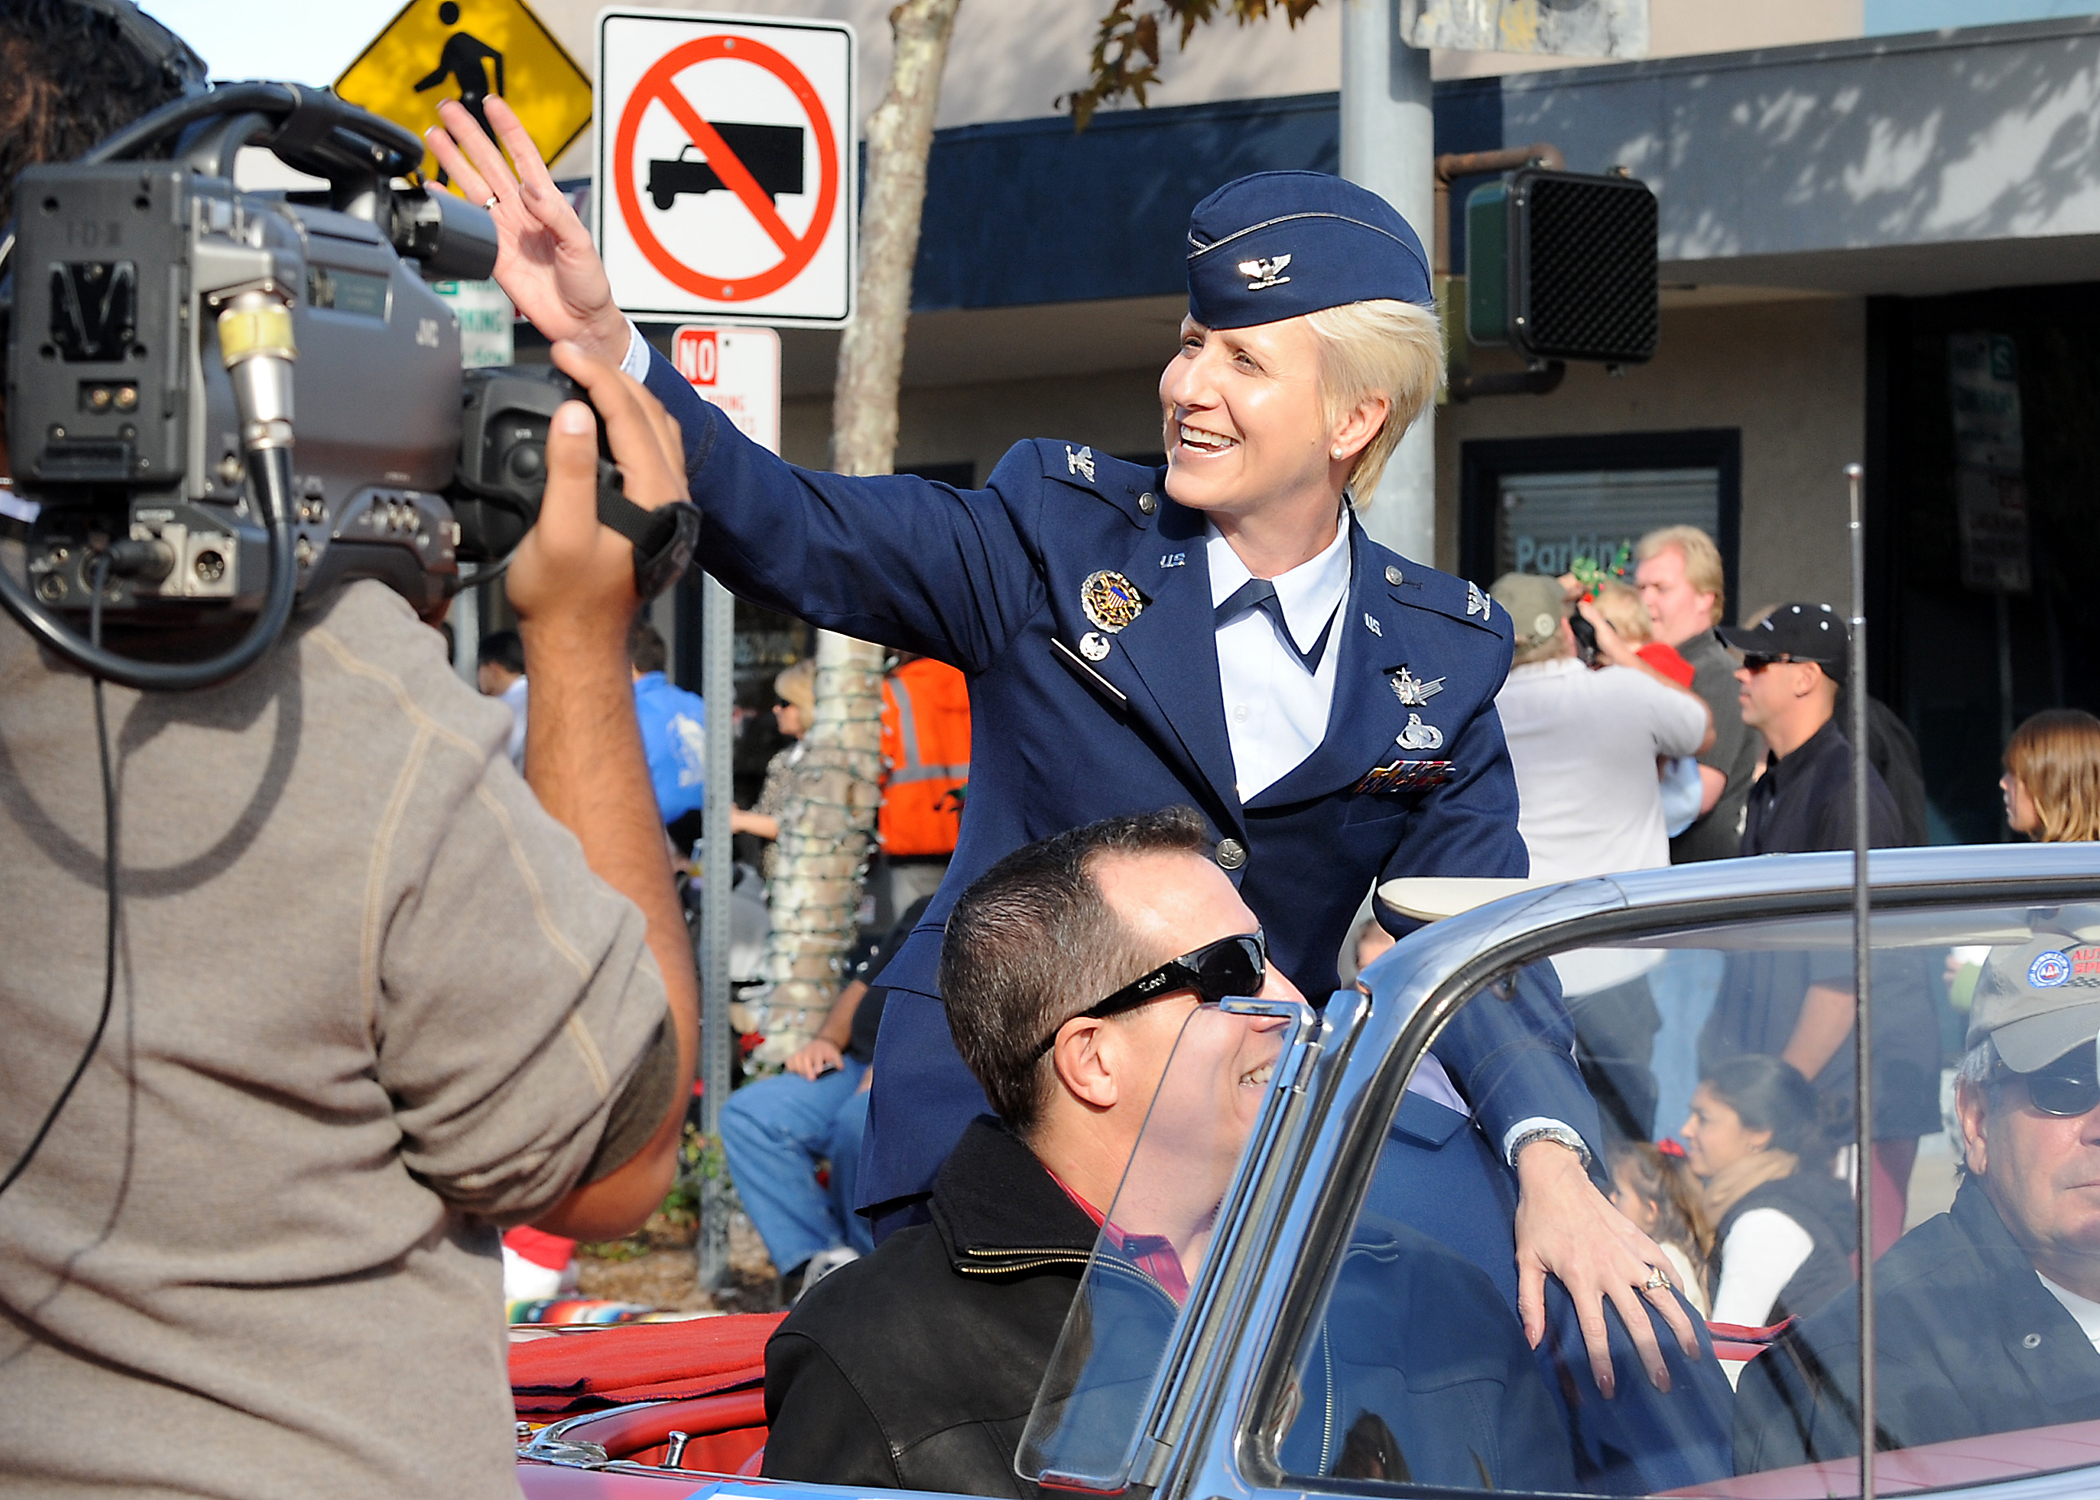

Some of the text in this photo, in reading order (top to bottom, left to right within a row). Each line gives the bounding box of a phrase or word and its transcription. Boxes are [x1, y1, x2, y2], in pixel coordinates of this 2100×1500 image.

[457, 308, 503, 333] RKING
[681, 338, 716, 382] NO
[1160, 552, 1185, 568] US
[1364, 612, 1383, 637] US
